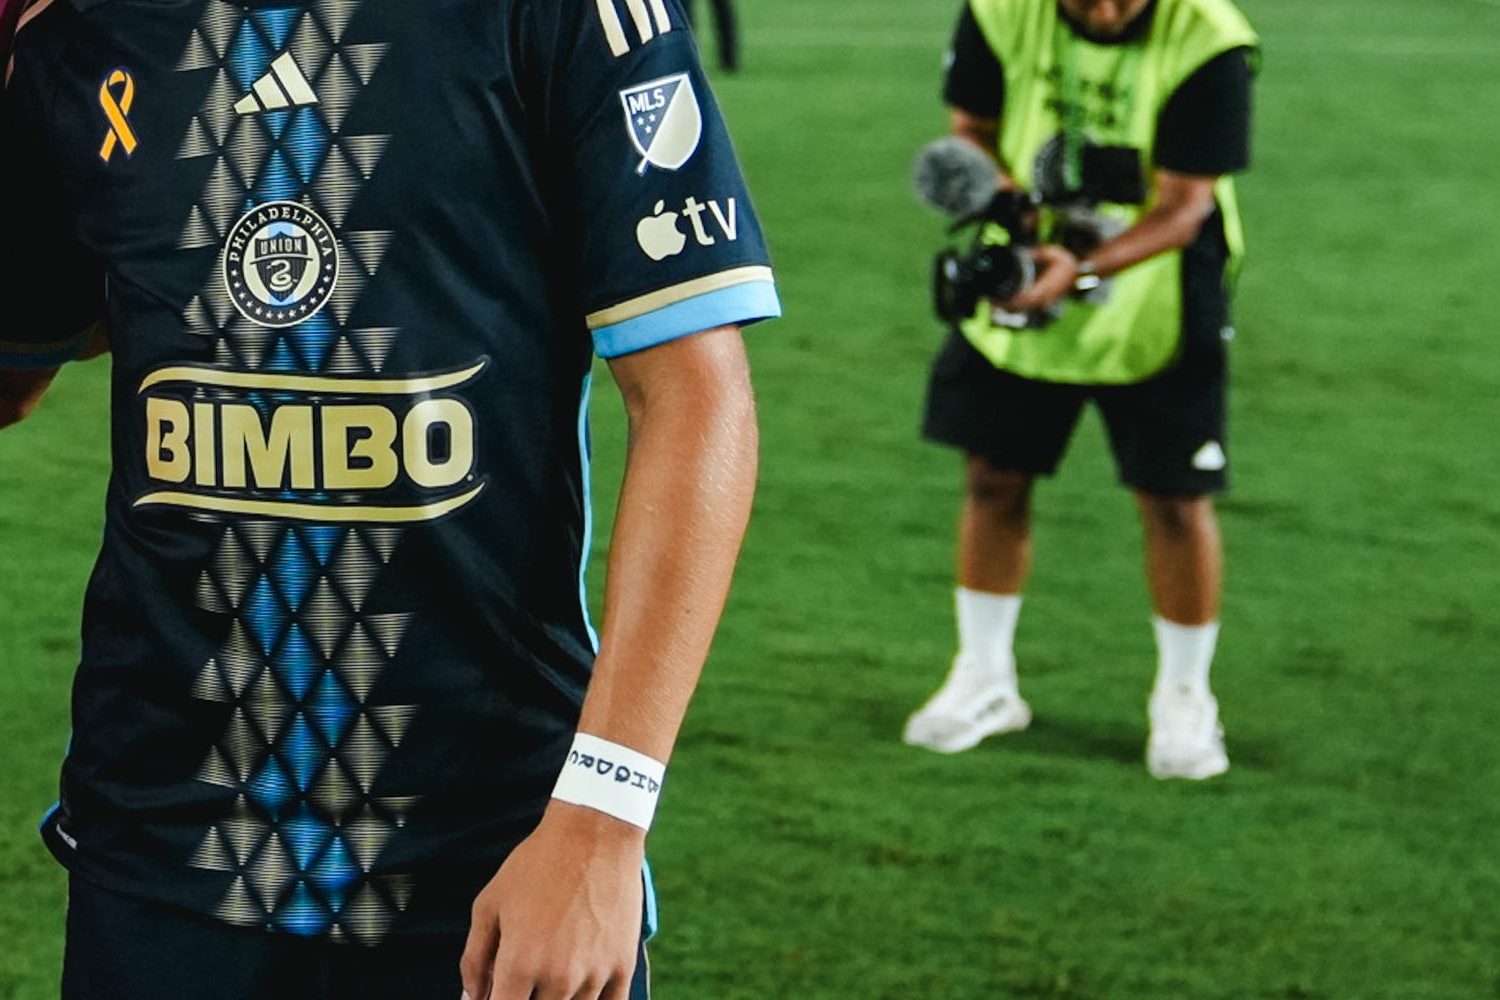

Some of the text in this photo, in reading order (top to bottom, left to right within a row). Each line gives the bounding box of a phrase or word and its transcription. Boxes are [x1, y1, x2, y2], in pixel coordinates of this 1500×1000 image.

[628, 88, 666, 115] MLS
[229, 206, 333, 262] PHILADELPHIA
[682, 196, 737, 246] tv
[260, 238, 302, 255] UNION
[145, 396, 475, 490] BIMBO
